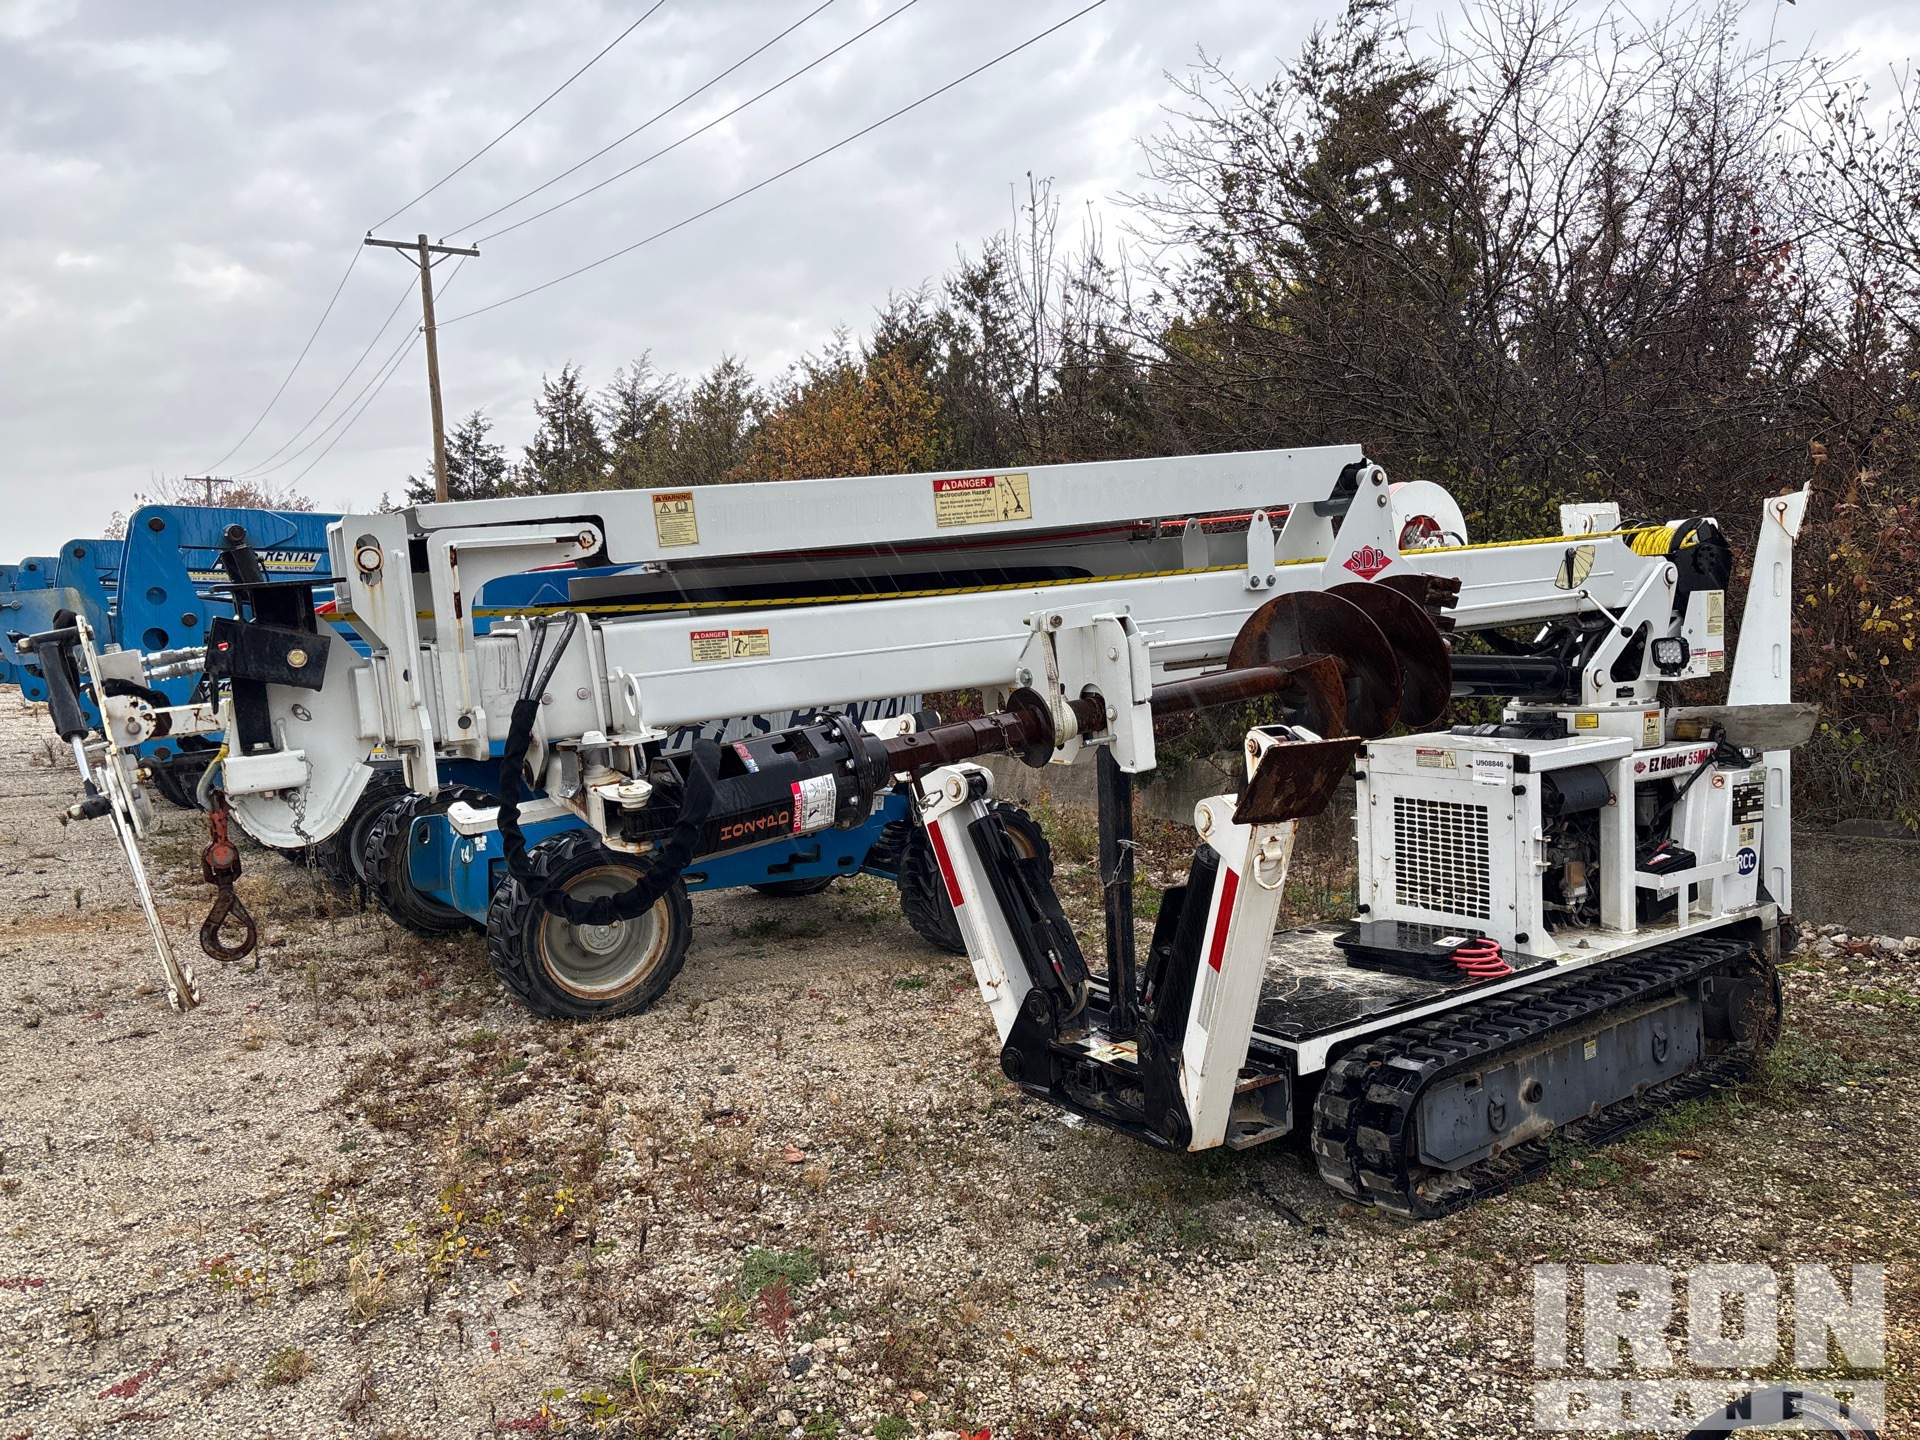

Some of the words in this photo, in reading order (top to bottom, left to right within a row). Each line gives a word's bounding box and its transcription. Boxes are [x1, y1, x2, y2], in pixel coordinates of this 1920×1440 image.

[950, 478, 987, 489] DANGER
[1352, 549, 1384, 570] SDP
[1476, 760, 1504, 768] U908846
[1649, 757, 1660, 772] EZ
[1660, 754, 1688, 770] Hauler
[794, 792, 802, 828] DANGER
[1738, 852, 1754, 870] RCC
